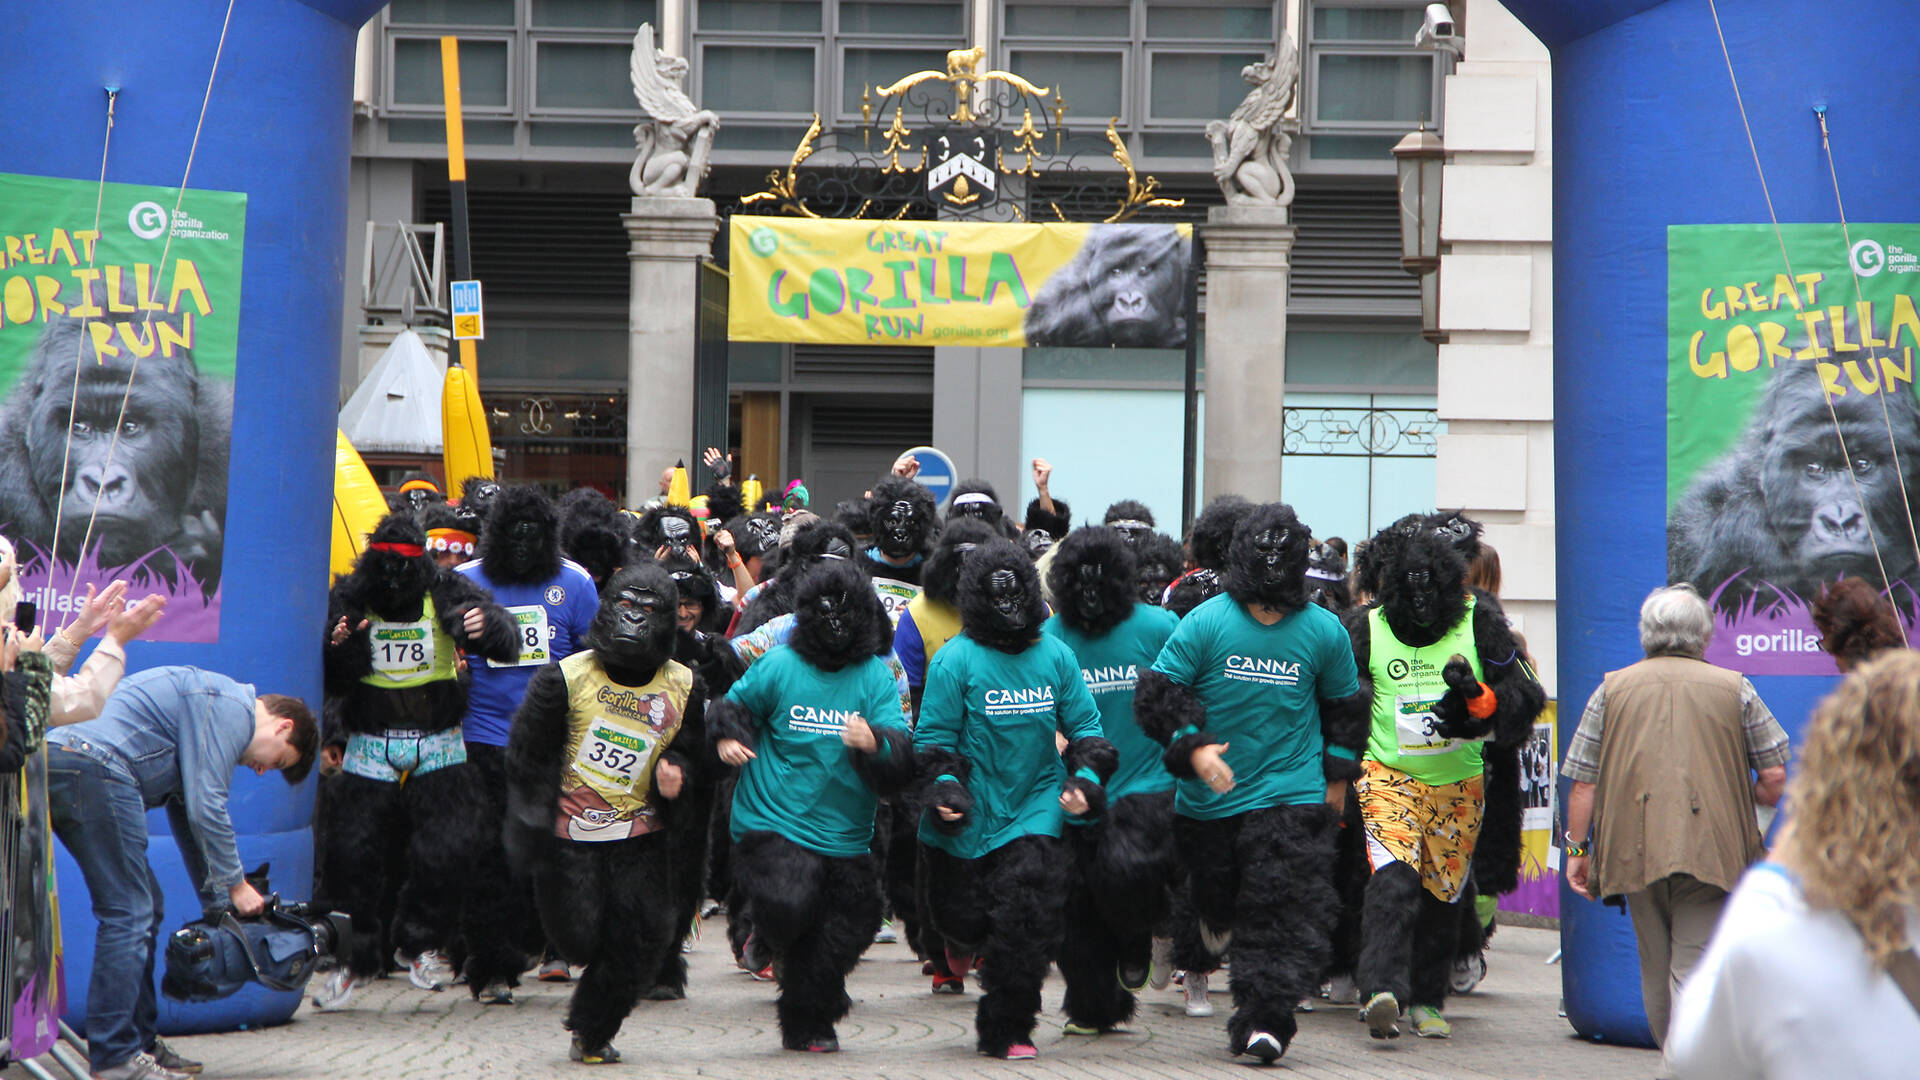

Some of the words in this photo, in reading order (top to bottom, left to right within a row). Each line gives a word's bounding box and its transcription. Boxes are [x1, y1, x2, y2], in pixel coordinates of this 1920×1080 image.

[170, 228, 229, 240] organization
[171, 217, 203, 229] gorilla
[866, 230, 949, 254] GREAT
[1888, 253, 1918, 265] gorilla
[0, 258, 213, 329] ORILLA
[768, 251, 1032, 320] GORILLA
[1701, 271, 1825, 321] GREAT
[88, 311, 195, 366] RUN
[865, 313, 924, 339] RUN
[932, 325, 1009, 339] gorillas.org
[1688, 293, 1920, 380] GORILLA
[1816, 346, 1915, 406] RUN
[381, 642, 425, 663] 178
[1736, 628, 1824, 657] gorilla
[1081, 664, 1139, 684] ANNA
[1226, 654, 1302, 676] CANNA
[597, 685, 640, 713] Gorilla
[985, 685, 1055, 705] CANNA
[589, 742, 637, 774] 352
